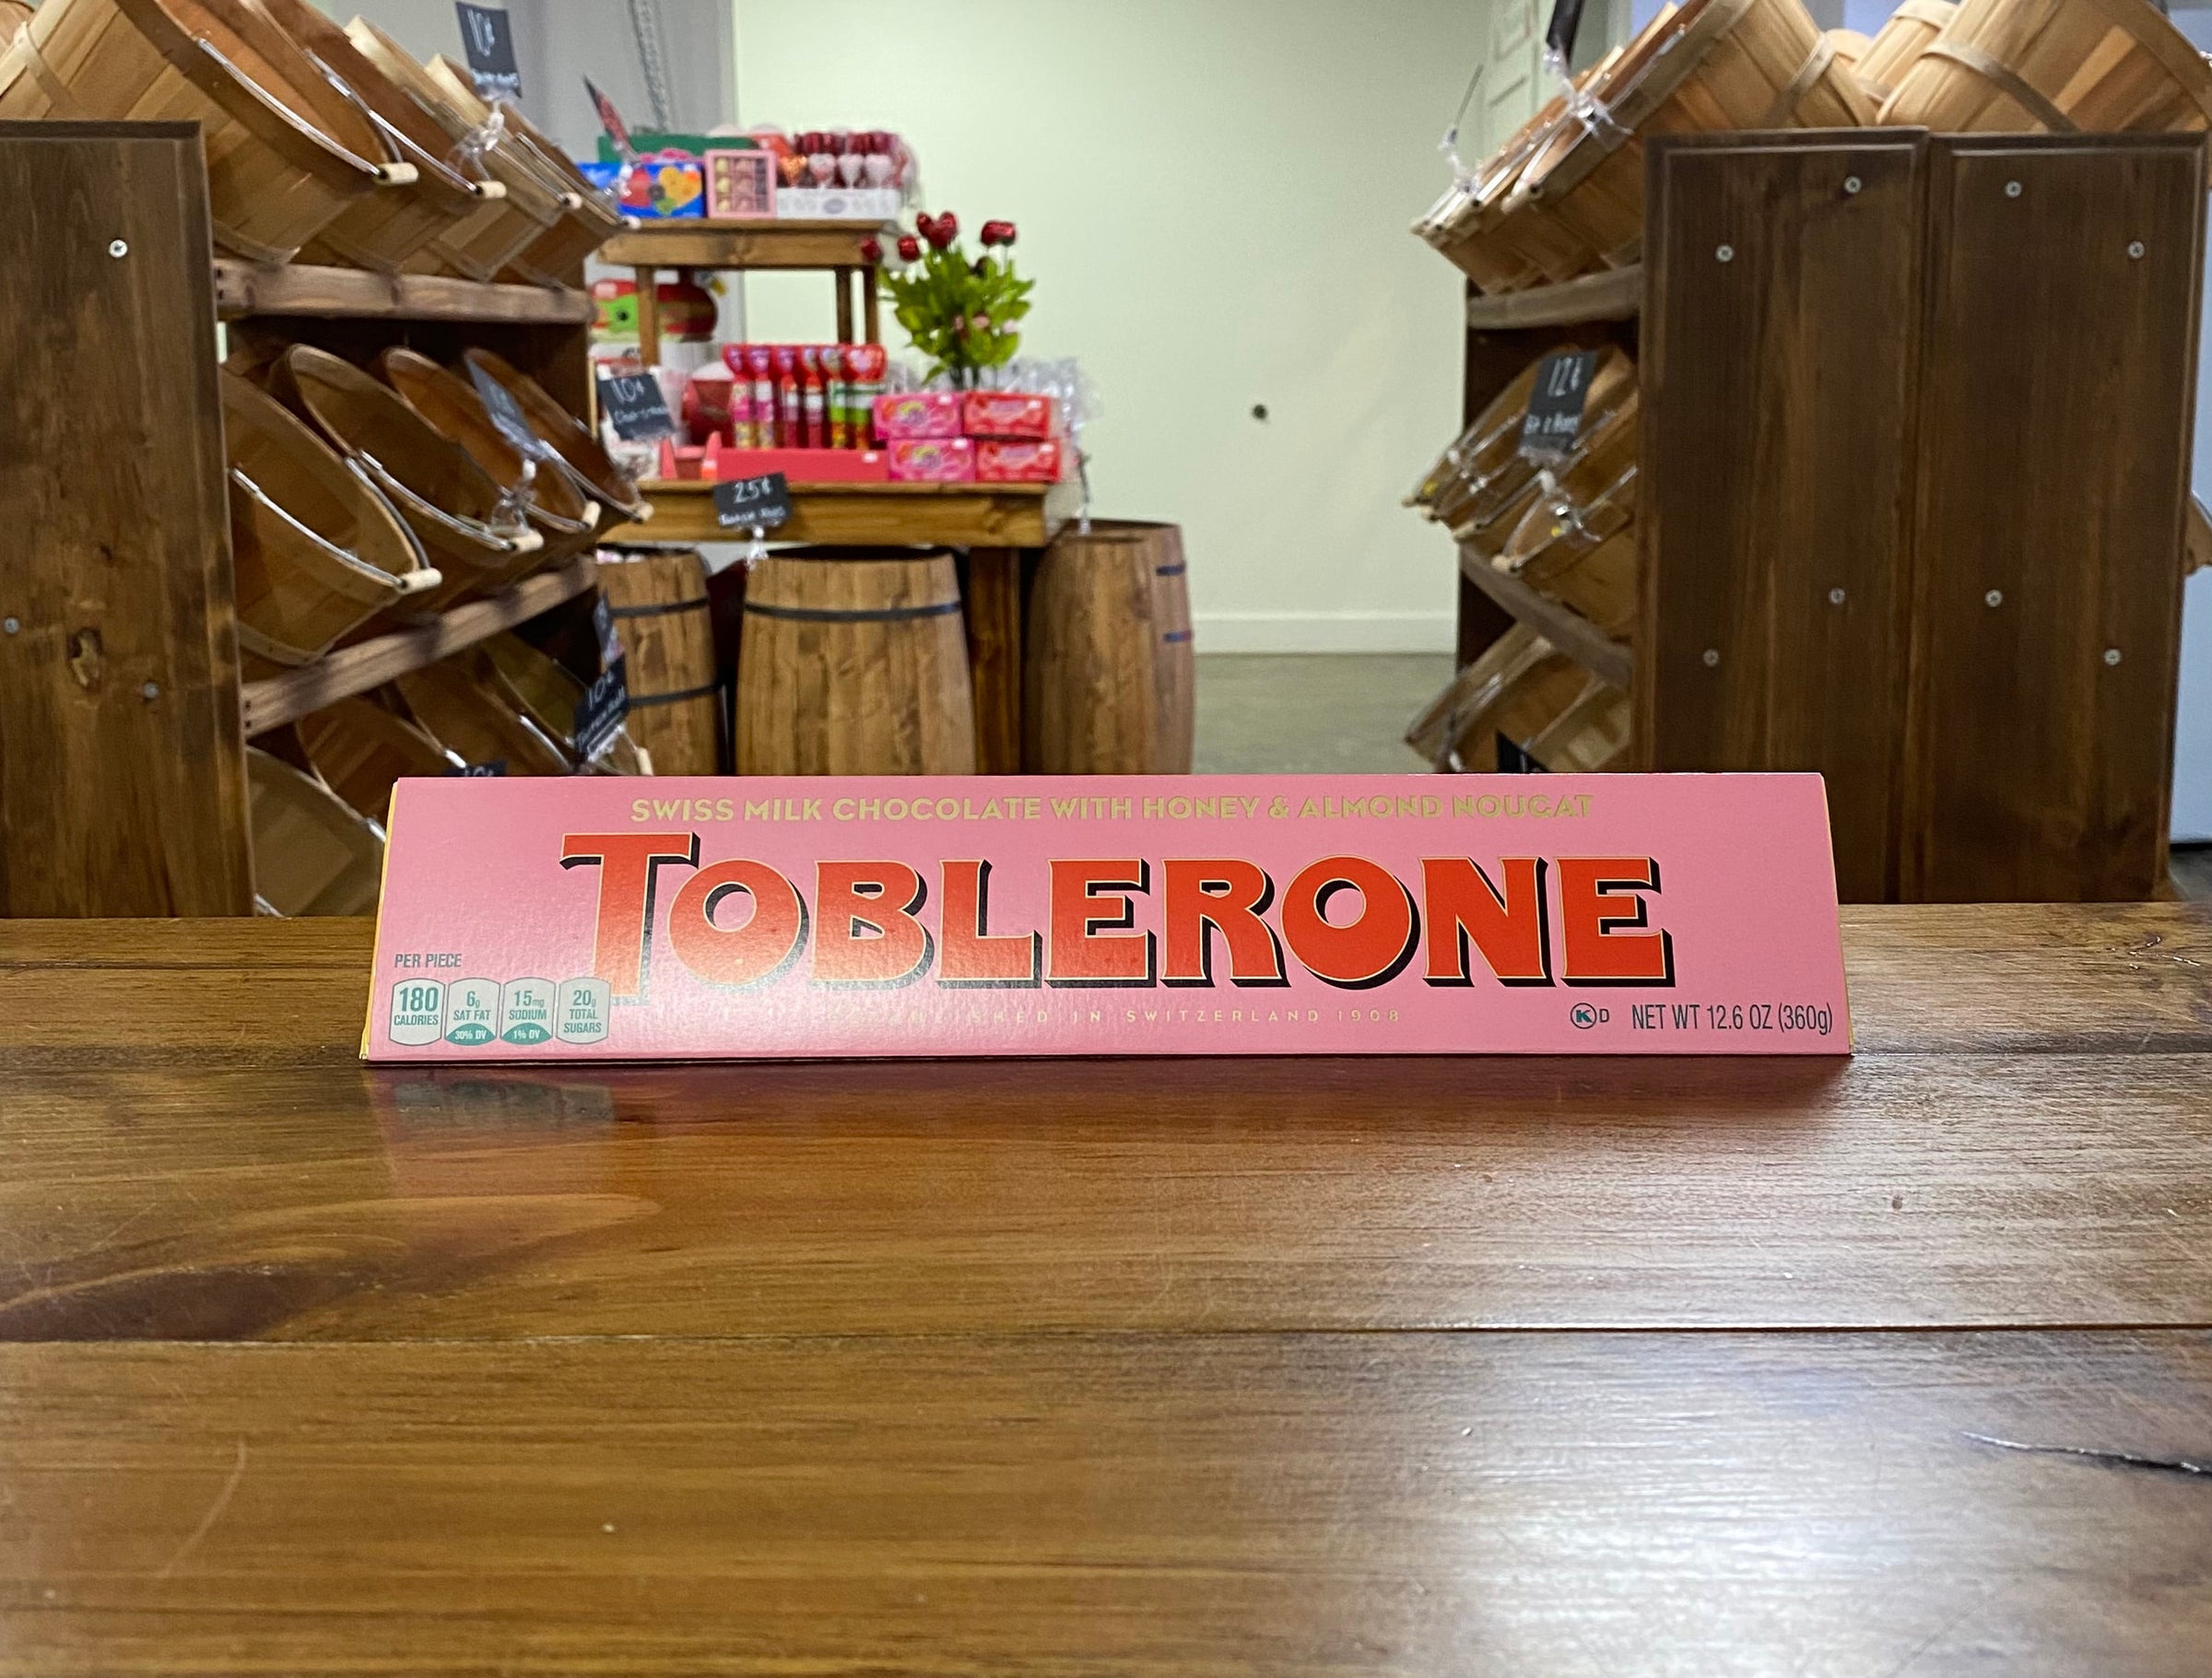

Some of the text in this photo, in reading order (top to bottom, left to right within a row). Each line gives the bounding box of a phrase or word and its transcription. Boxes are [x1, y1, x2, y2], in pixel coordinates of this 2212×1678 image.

[630, 794, 1595, 822] SWISS MILK CHOCOLATE WITH HONEY & ALMOND NOUGAT
[559, 831, 1676, 1005] TOBLERONE
[394, 954, 463, 968] PER PIECE
[399, 987, 439, 1012] 180
[514, 990, 545, 1008] 15mg
[394, 1015, 439, 1026] CALORIES
[453, 1009, 491, 1021] SAT FAT
[509, 1009, 547, 1020] SODIUM
[570, 1009, 598, 1020] TOTAL
[1126, 1010, 1320, 1022] SWITZERLAND
[1336, 1010, 1399, 1022] 1908
[1632, 1002, 1833, 1035] NET WT 12.6 OZ (360g)
[563, 1022, 602, 1033] SUGARS
[454, 1029, 487, 1040] 30% DV
[513, 1029, 541, 1039] 1% DV
